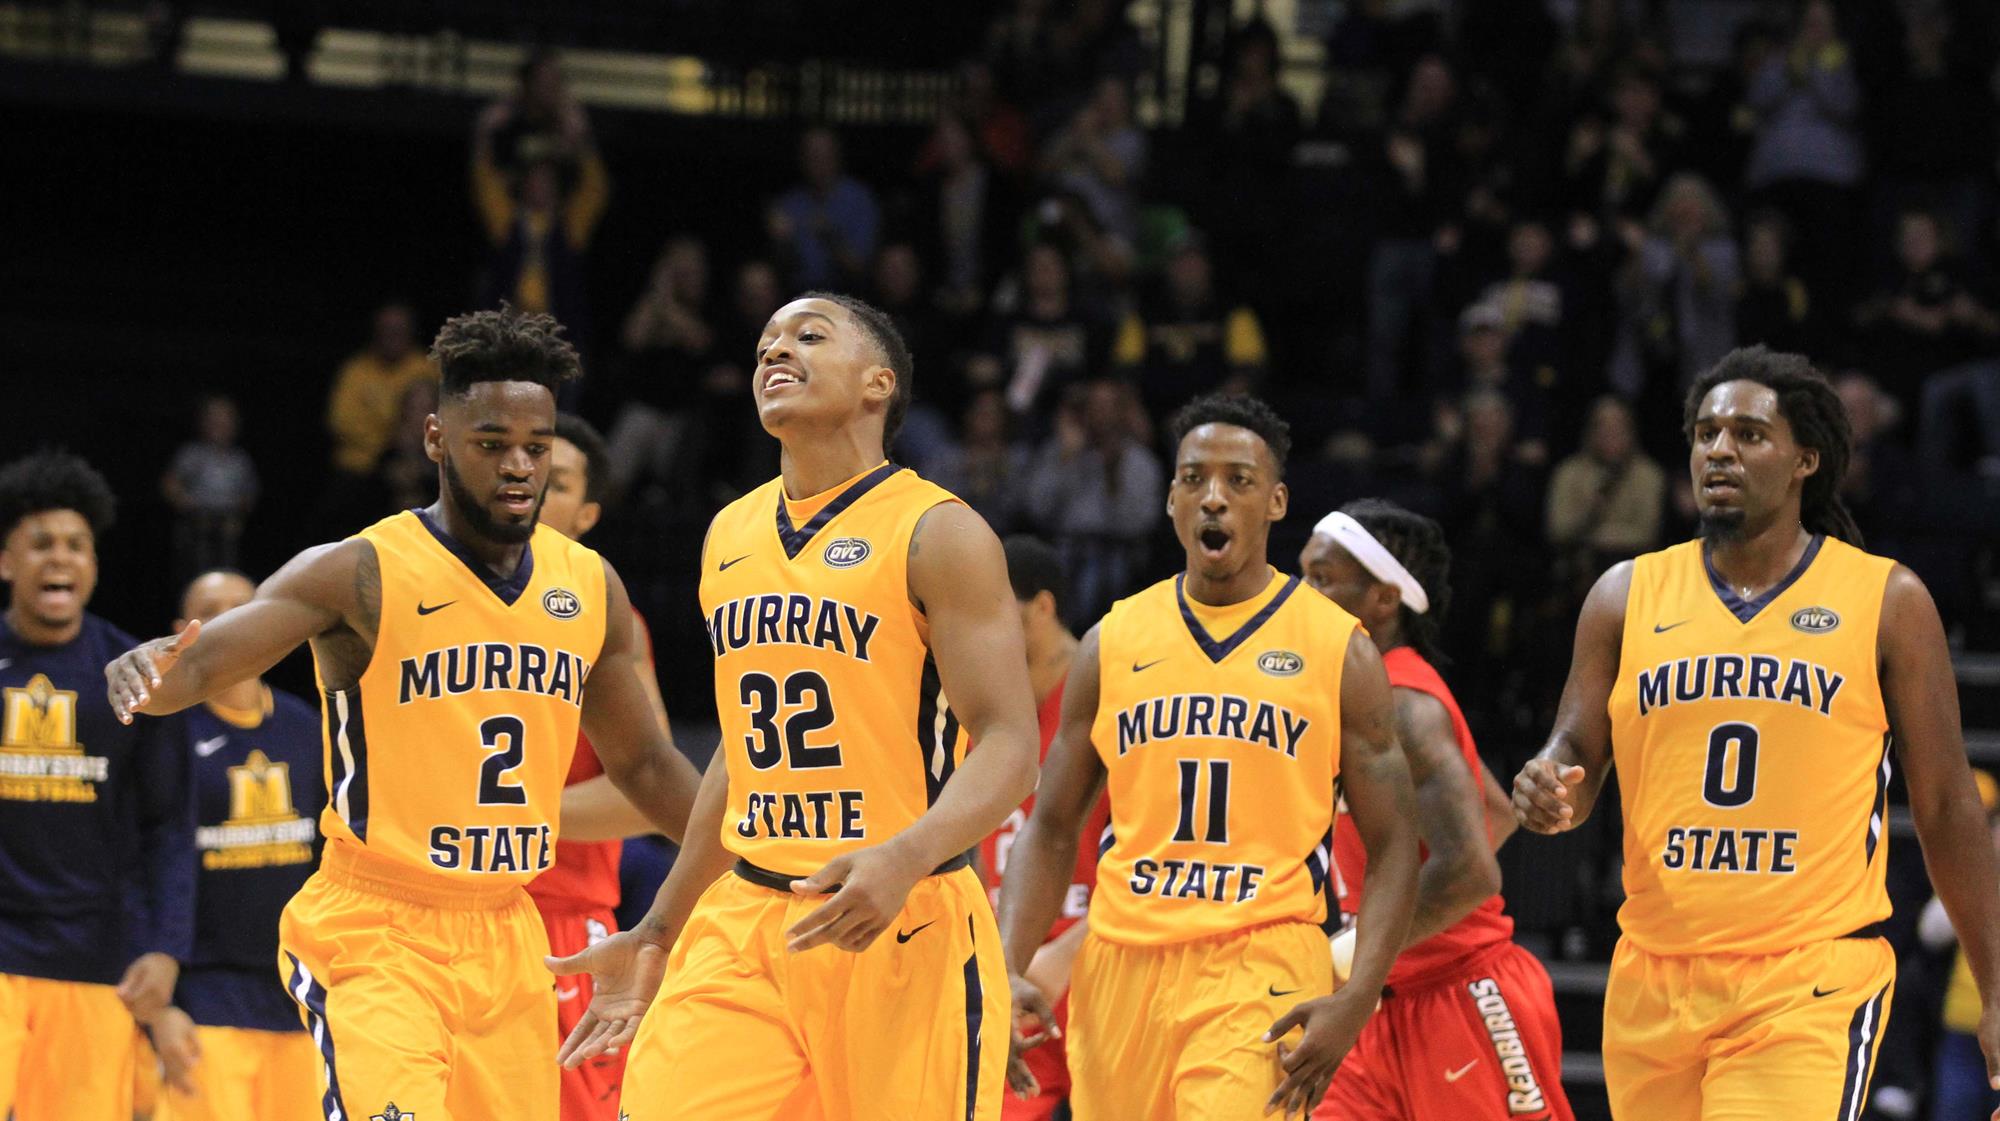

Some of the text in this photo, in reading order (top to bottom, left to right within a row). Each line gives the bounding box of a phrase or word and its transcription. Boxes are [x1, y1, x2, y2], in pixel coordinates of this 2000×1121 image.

[706, 592, 880, 662] MURRAY
[399, 642, 590, 708] MURRAY
[1638, 654, 1845, 717] MURRAY
[739, 670, 842, 771] 32
[1116, 693, 1311, 758] MURRAY
[476, 714, 528, 807] 2
[1702, 721, 1760, 809] 0
[737, 790, 866, 840] STATE
[1170, 758, 1231, 845] 11
[428, 824, 551, 873] STATE
[1130, 857, 1265, 904] STATE
[1662, 826, 1799, 874] STATE
[1468, 976, 1547, 1114] REDBIRDS
